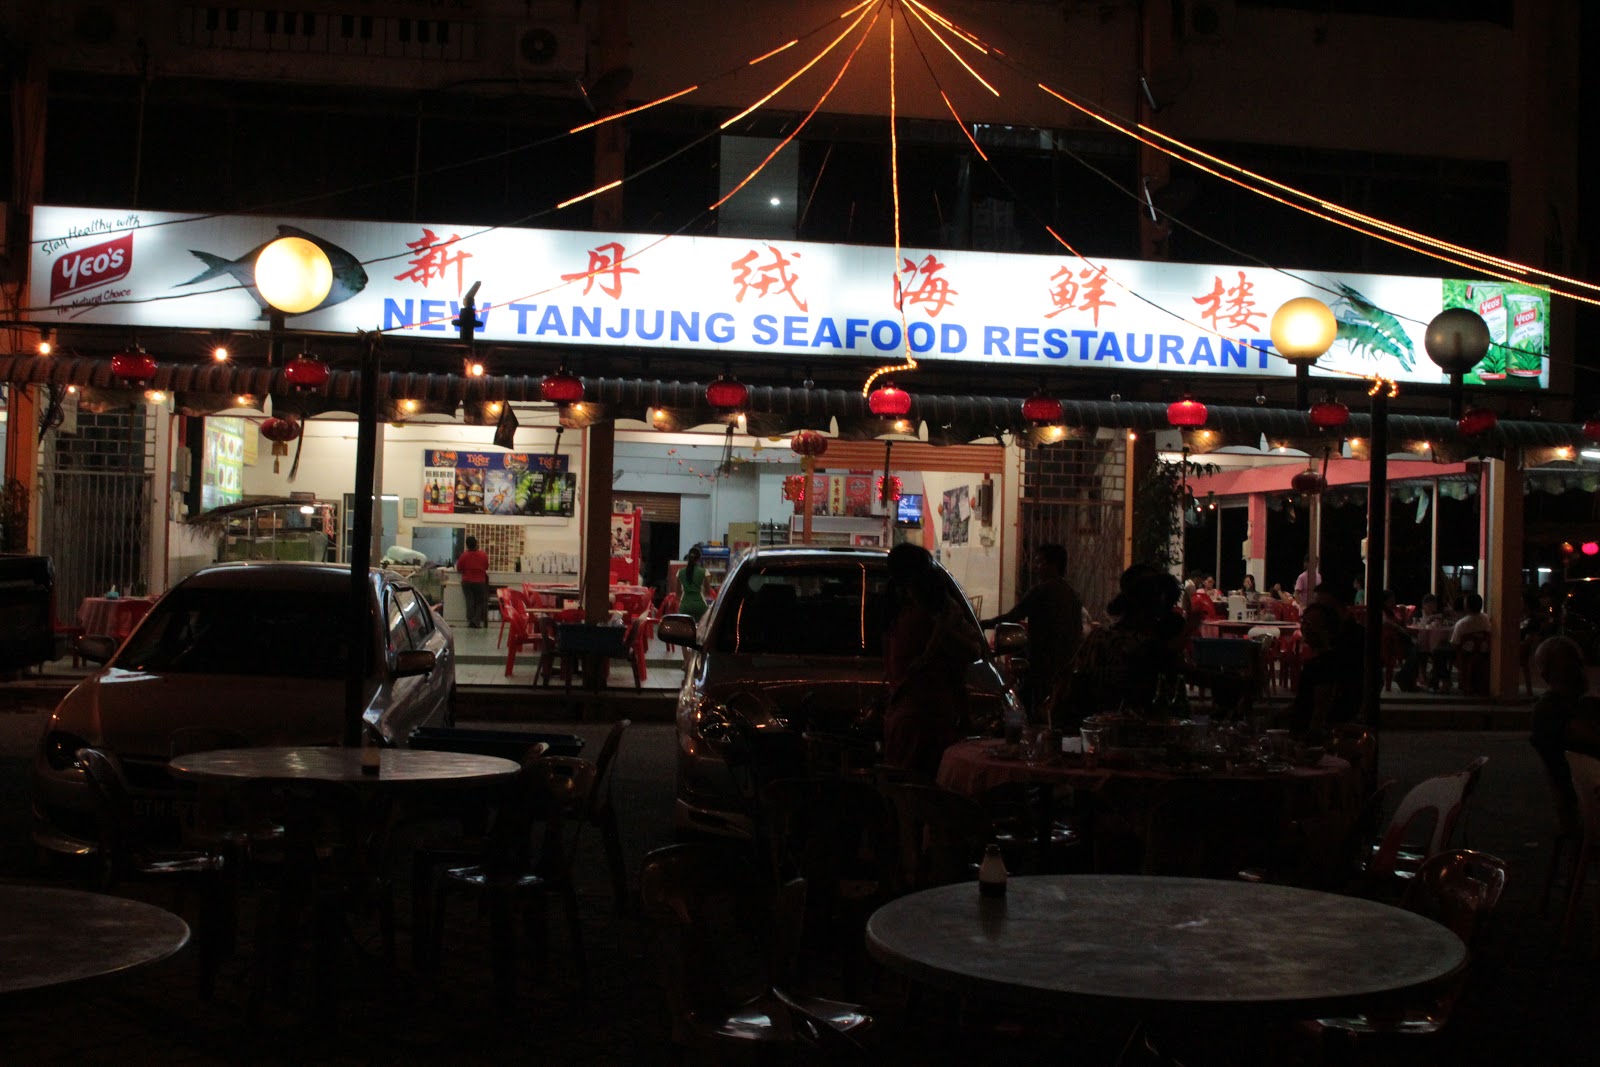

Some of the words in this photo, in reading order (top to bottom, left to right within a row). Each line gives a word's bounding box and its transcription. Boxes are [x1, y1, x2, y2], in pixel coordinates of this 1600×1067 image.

[42, 237, 69, 256] Stay
[69, 218, 112, 239] Healthy
[117, 214, 141, 229] with
[384, 298, 489, 339] NEW
[509, 303, 734, 344] TANJUNG
[753, 314, 968, 354] SEAFOOD
[984, 325, 1275, 370] RESTAURANT
[466, 454, 490, 467] Tiger
[538, 456, 561, 469] Tigr
